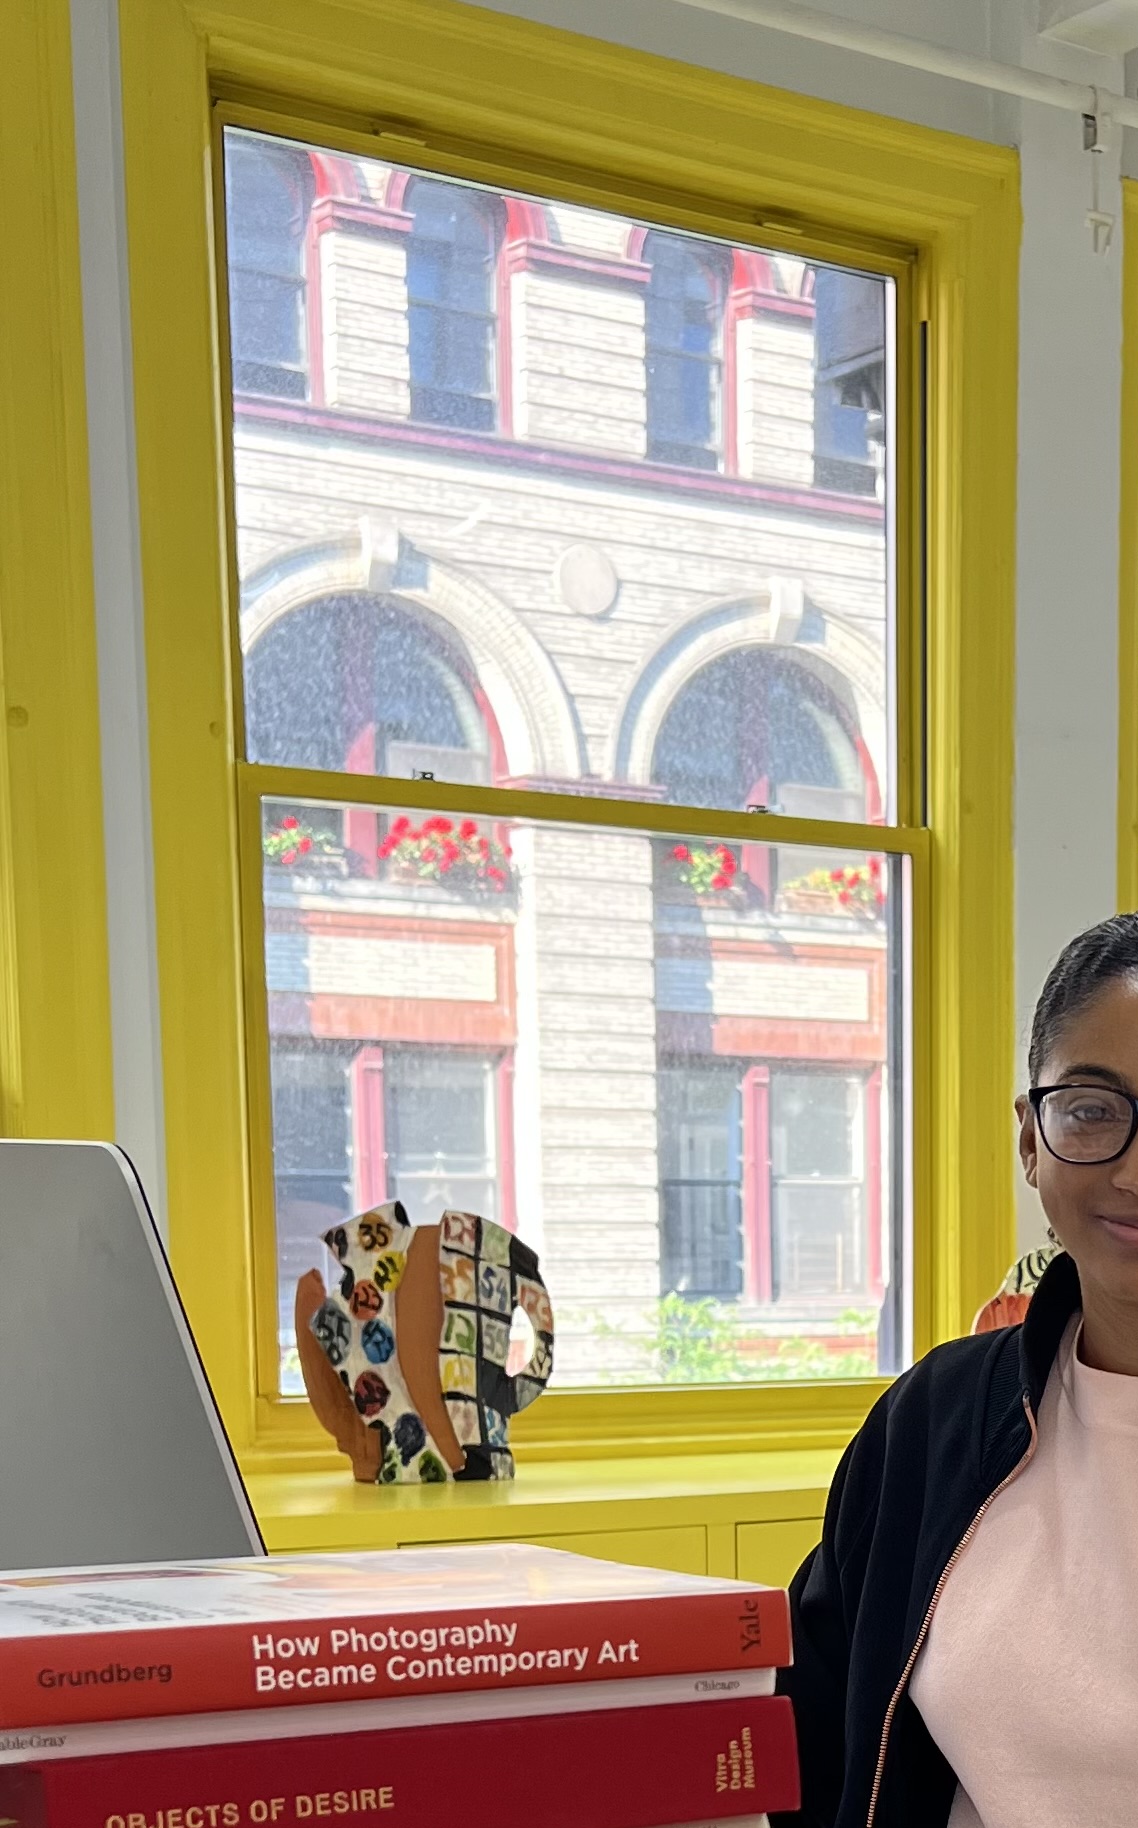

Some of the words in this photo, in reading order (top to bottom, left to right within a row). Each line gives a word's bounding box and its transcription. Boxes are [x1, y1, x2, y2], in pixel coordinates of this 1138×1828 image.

[358, 1223, 389, 1251] 35
[252, 1633, 320, 1661] How
[331, 1618, 518, 1655] Photography
[740, 1599, 762, 1654] Yale
[37, 1663, 173, 1690] Grundberg
[255, 1662, 377, 1692] Became
[386, 1644, 590, 1681] Contemporary
[598, 1638, 640, 1664] Art
[694, 1678, 741, 1694] Chicago
[715, 1752, 728, 1793] Vitra
[728, 1738, 742, 1791] Design
[741, 1726, 756, 1789] Museum
[250, 1798, 286, 1825] OF
[295, 1785, 395, 1820] DESIRE
